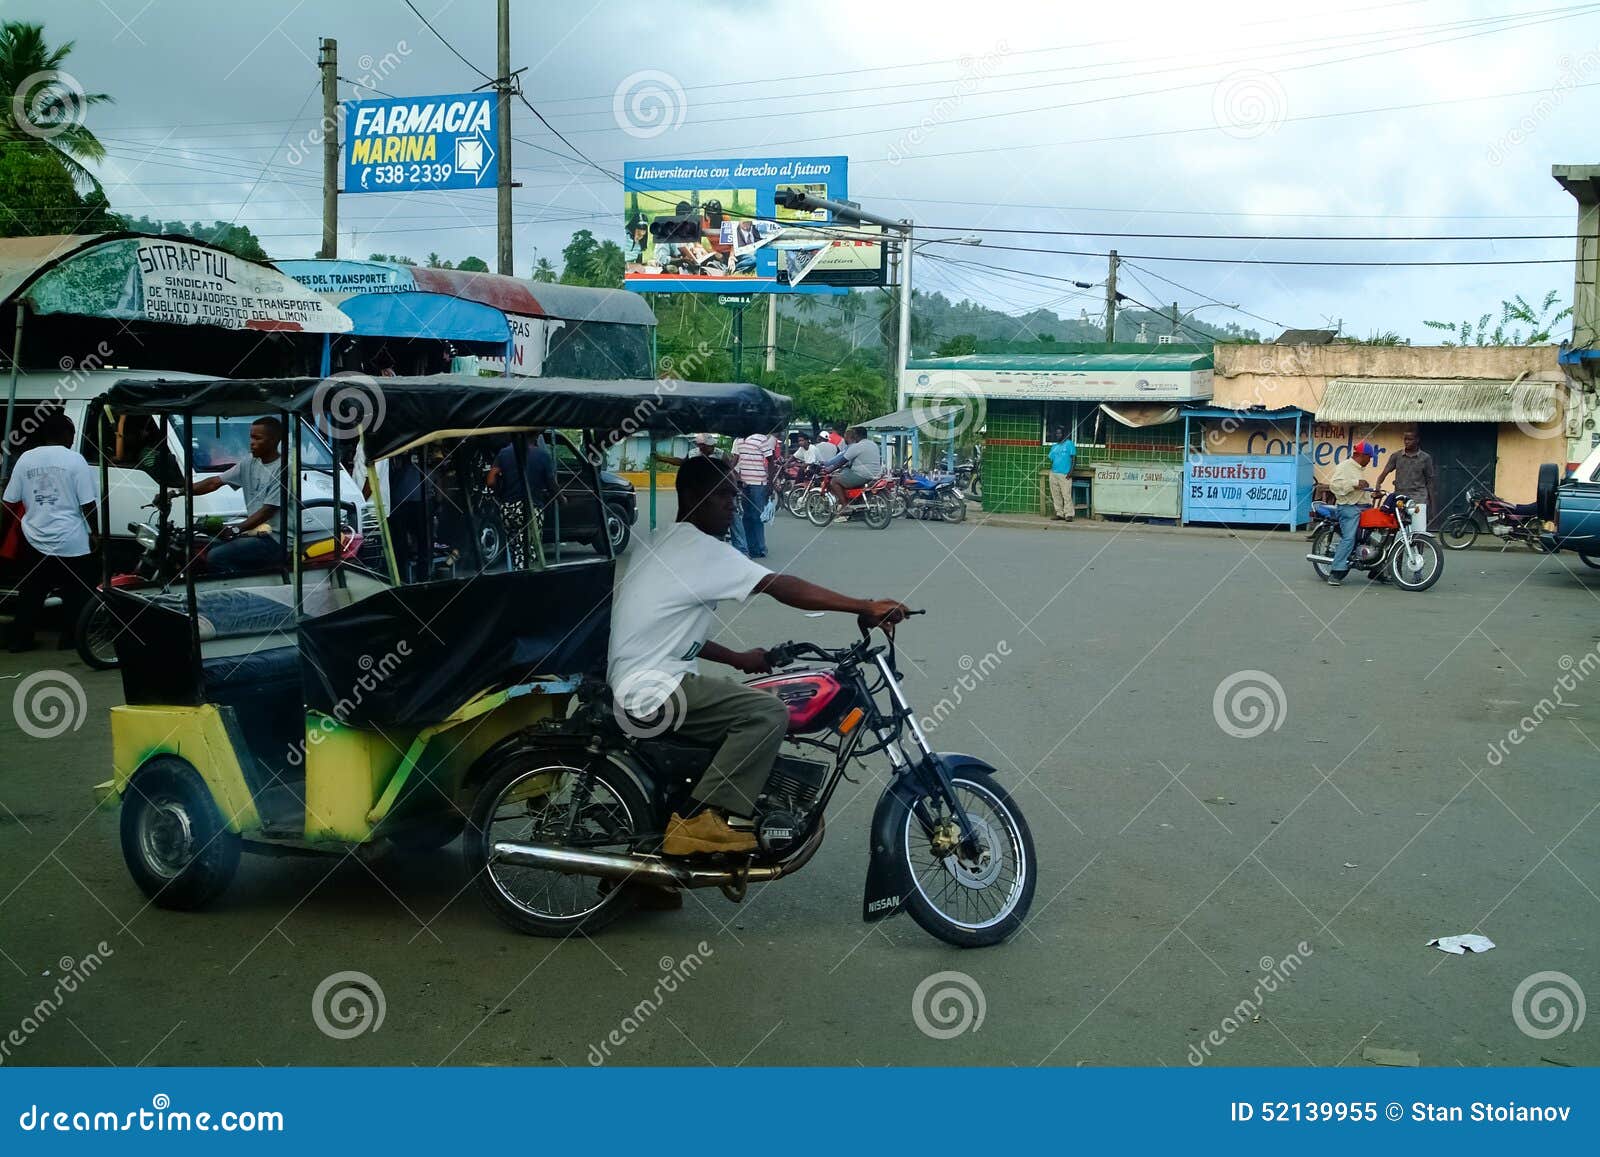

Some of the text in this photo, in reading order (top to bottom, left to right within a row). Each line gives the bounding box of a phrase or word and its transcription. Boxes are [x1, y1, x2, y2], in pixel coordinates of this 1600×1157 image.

[354, 100, 491, 136] FARMACIA
[352, 135, 436, 165] MARINA
[375, 163, 452, 184] 538-2339
[634, 161, 831, 180] Universitarios con derecho al futuro
[137, 245, 237, 285] SITRAPTUL
[165, 276, 223, 292] SINDICATO
[312, 275, 328, 285] DEL
[329, 274, 387, 286] TRANSPORTE
[149, 286, 323, 312] DE TRABAJADORES DE TRANSPORTE
[147, 299, 190, 314] PUBLICO
[203, 304, 249, 320] TURISTICO
[252, 310, 273, 321] DEL
[278, 311, 308, 322] LIMON
[1191, 486, 1204, 499] ES
[1207, 486, 1219, 499] LA
[1220, 487, 1242, 500] VIDA
[868, 895, 900, 912] NISSAN
